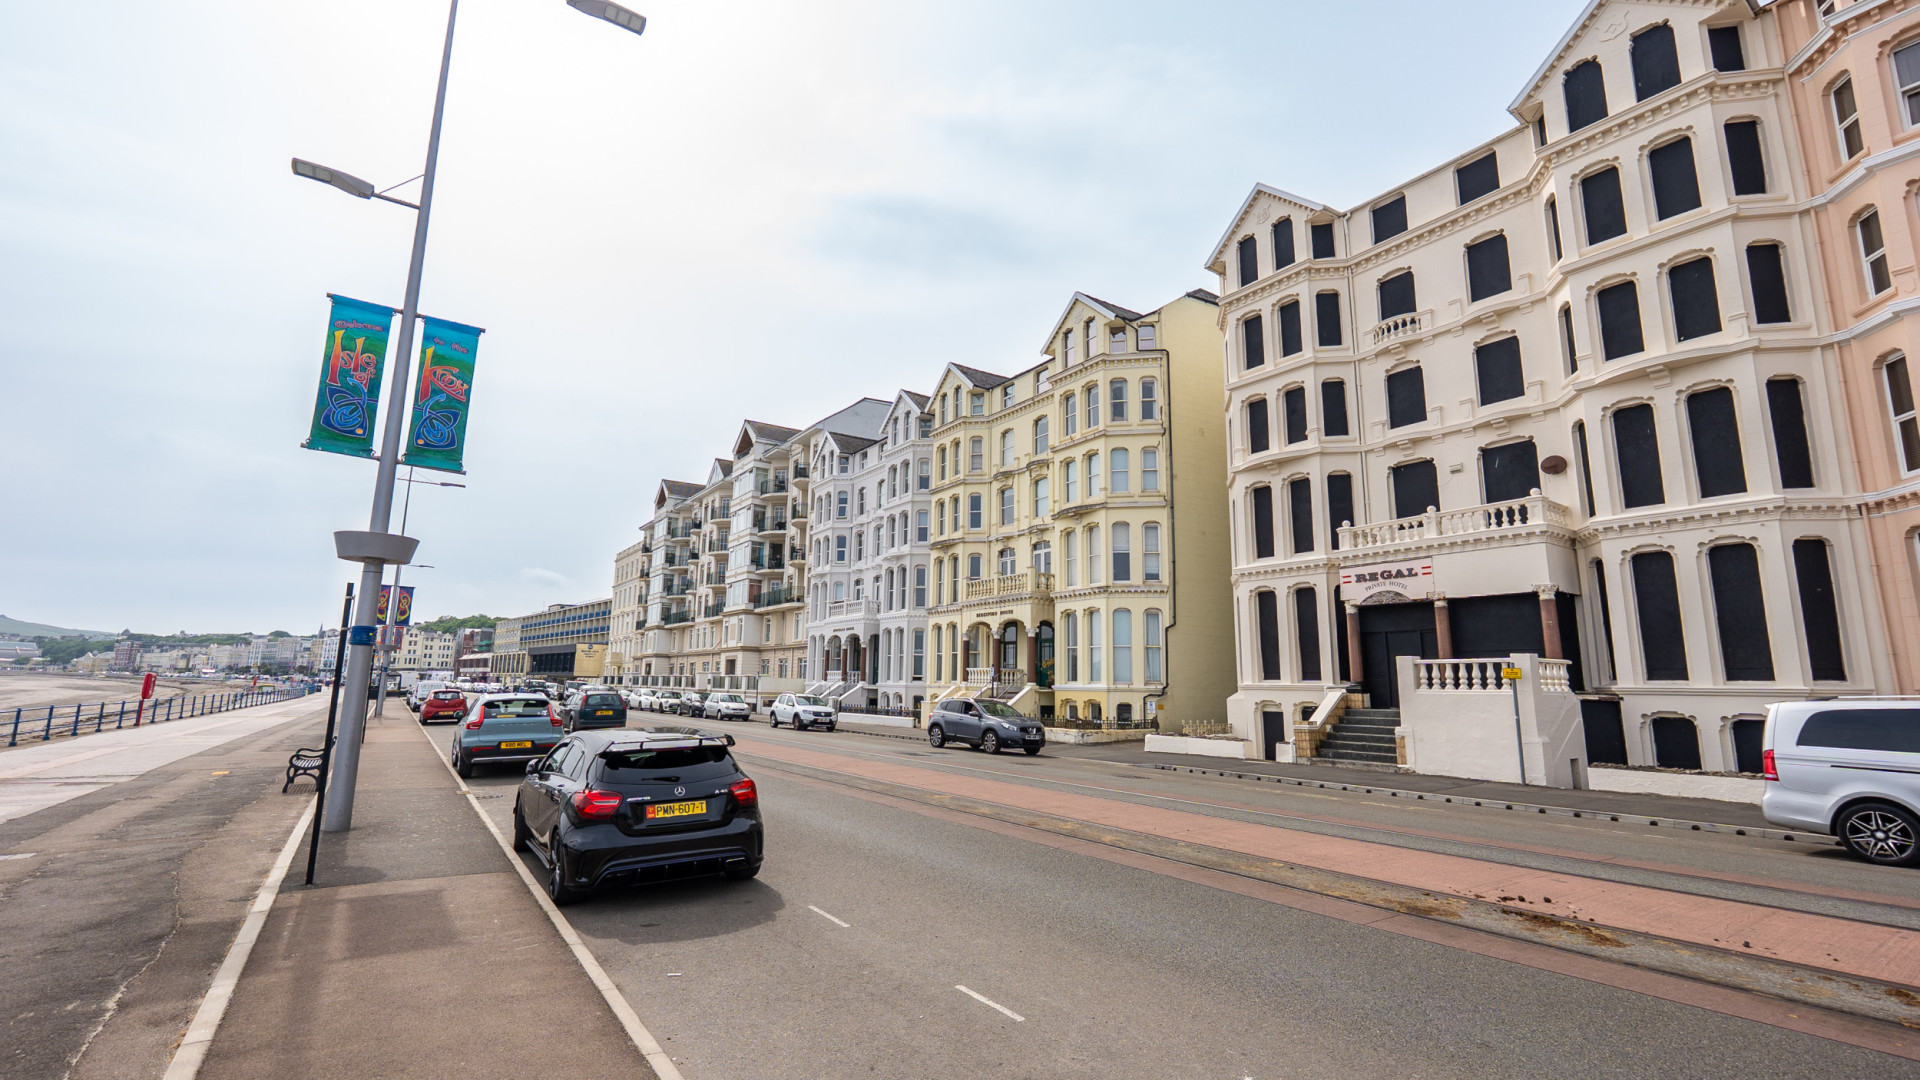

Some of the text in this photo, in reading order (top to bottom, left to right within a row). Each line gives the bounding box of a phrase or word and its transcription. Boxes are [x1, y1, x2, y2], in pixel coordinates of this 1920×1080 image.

[433, 337, 468, 354] to the
[326, 329, 376, 387] Isle
[354, 368, 376, 391] of
[1355, 567, 1418, 583] REGAL
[1365, 581, 1408, 592] PRIVATE HOTEL
[656, 801, 705, 816] PMN-607-T
